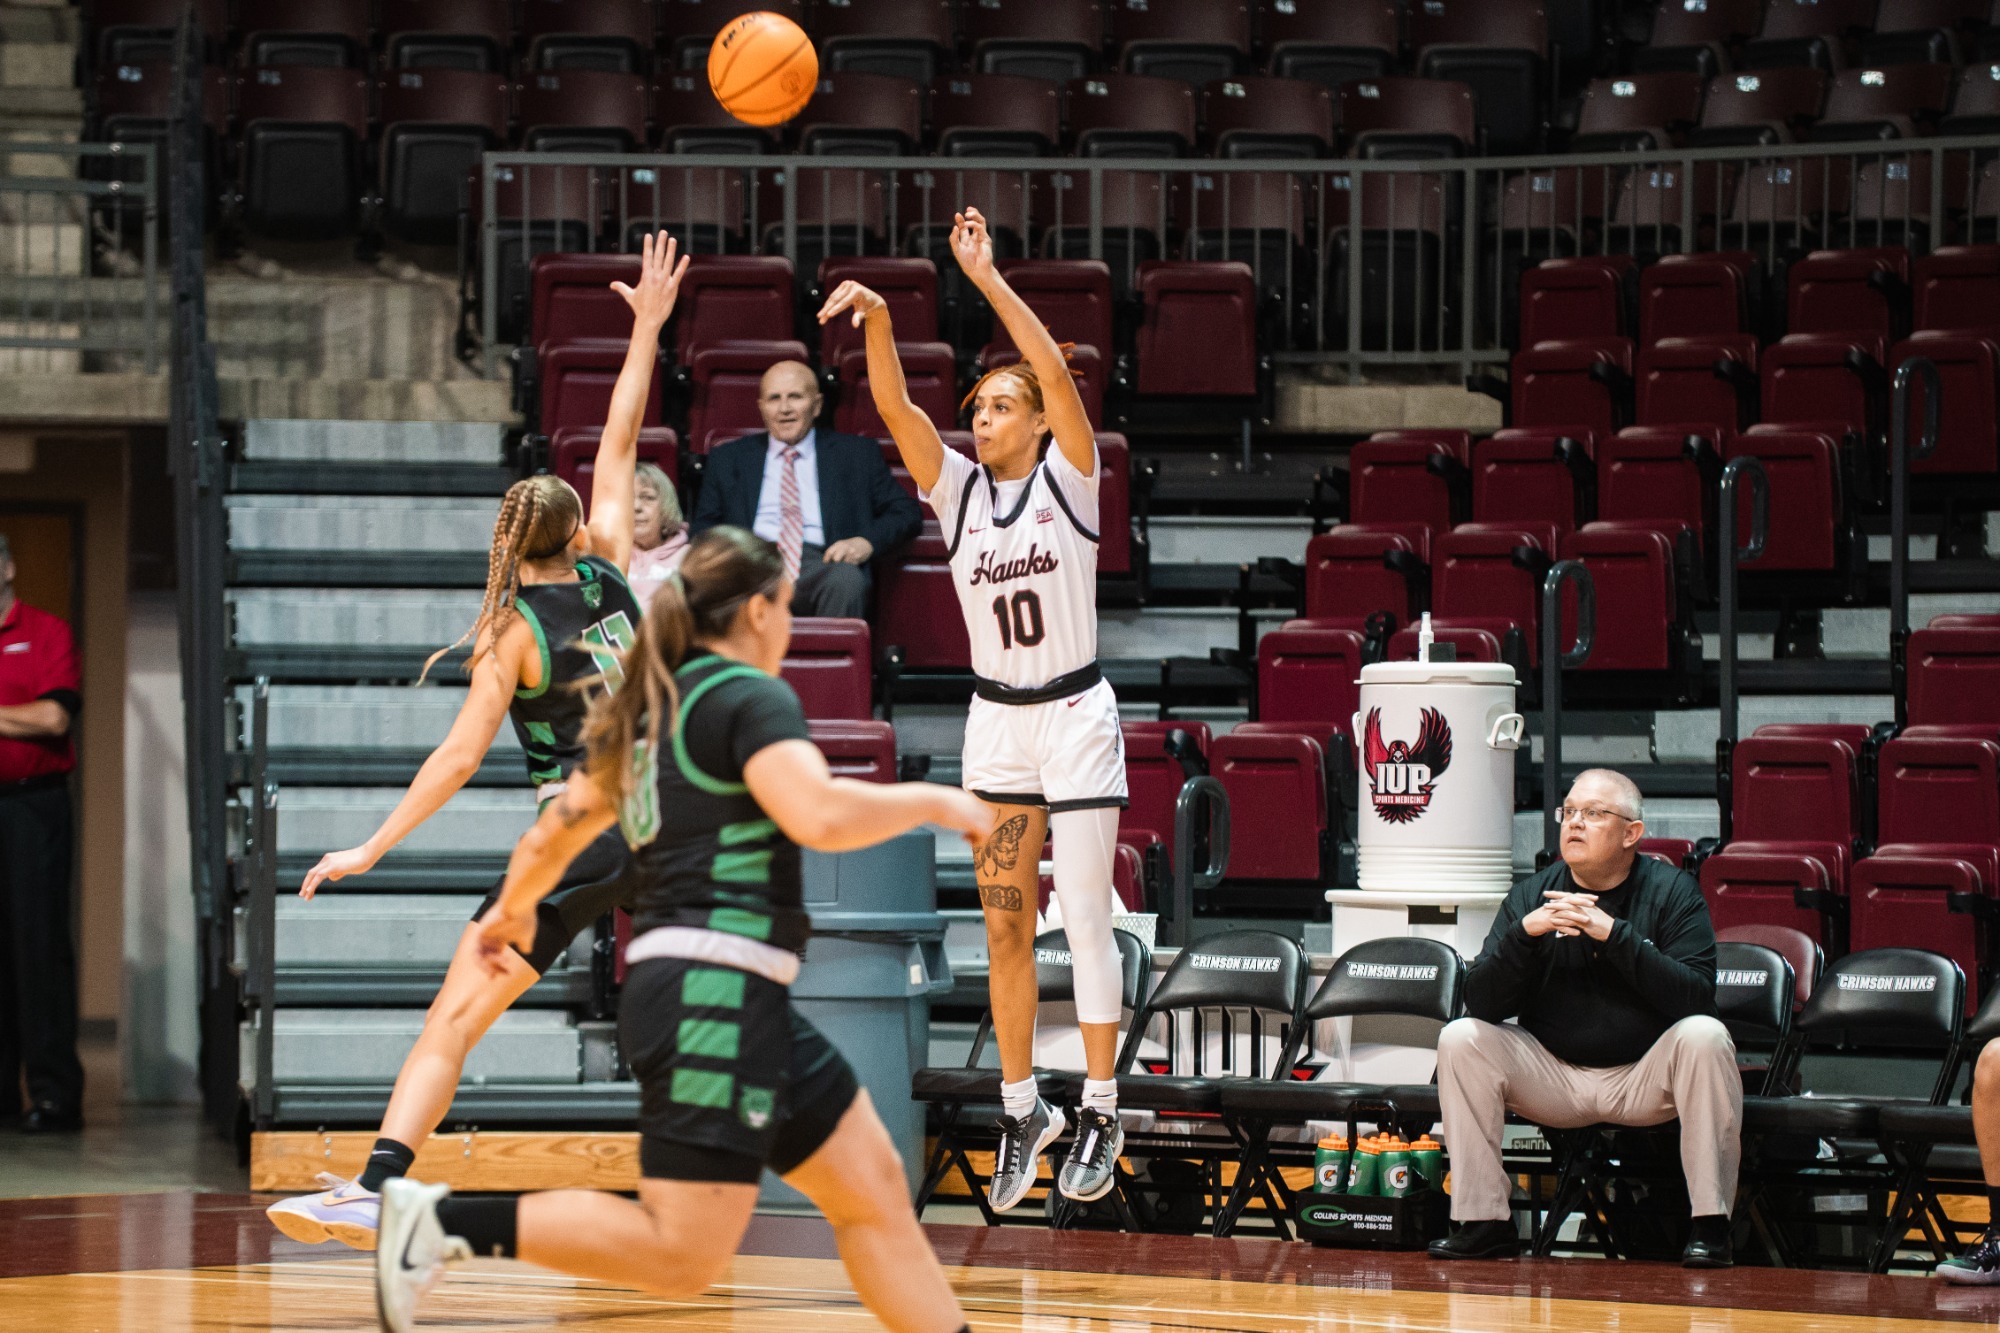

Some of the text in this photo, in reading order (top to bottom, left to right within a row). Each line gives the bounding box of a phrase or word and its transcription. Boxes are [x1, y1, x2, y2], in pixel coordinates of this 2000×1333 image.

[970, 543, 1059, 586] Hawks
[992, 589, 1046, 651] 10
[1376, 763, 1431, 794] IUP
[1375, 795, 1425, 804] SPORTS MEDICINE
[1036, 950, 1074, 965] CRIMS
[1191, 953, 1281, 971] CRIMSON HAWKS
[1348, 962, 1437, 979] CRIMSON HAWKS
[1726, 971, 1767, 985] HAWKS
[1839, 975, 1935, 990] CRIMSON HAWKS
[1318, 1164, 1339, 1187] G
[1389, 1165, 1408, 1188] G
[1313, 1211, 1393, 1223] COLLINS SPORTS MEDICINE
